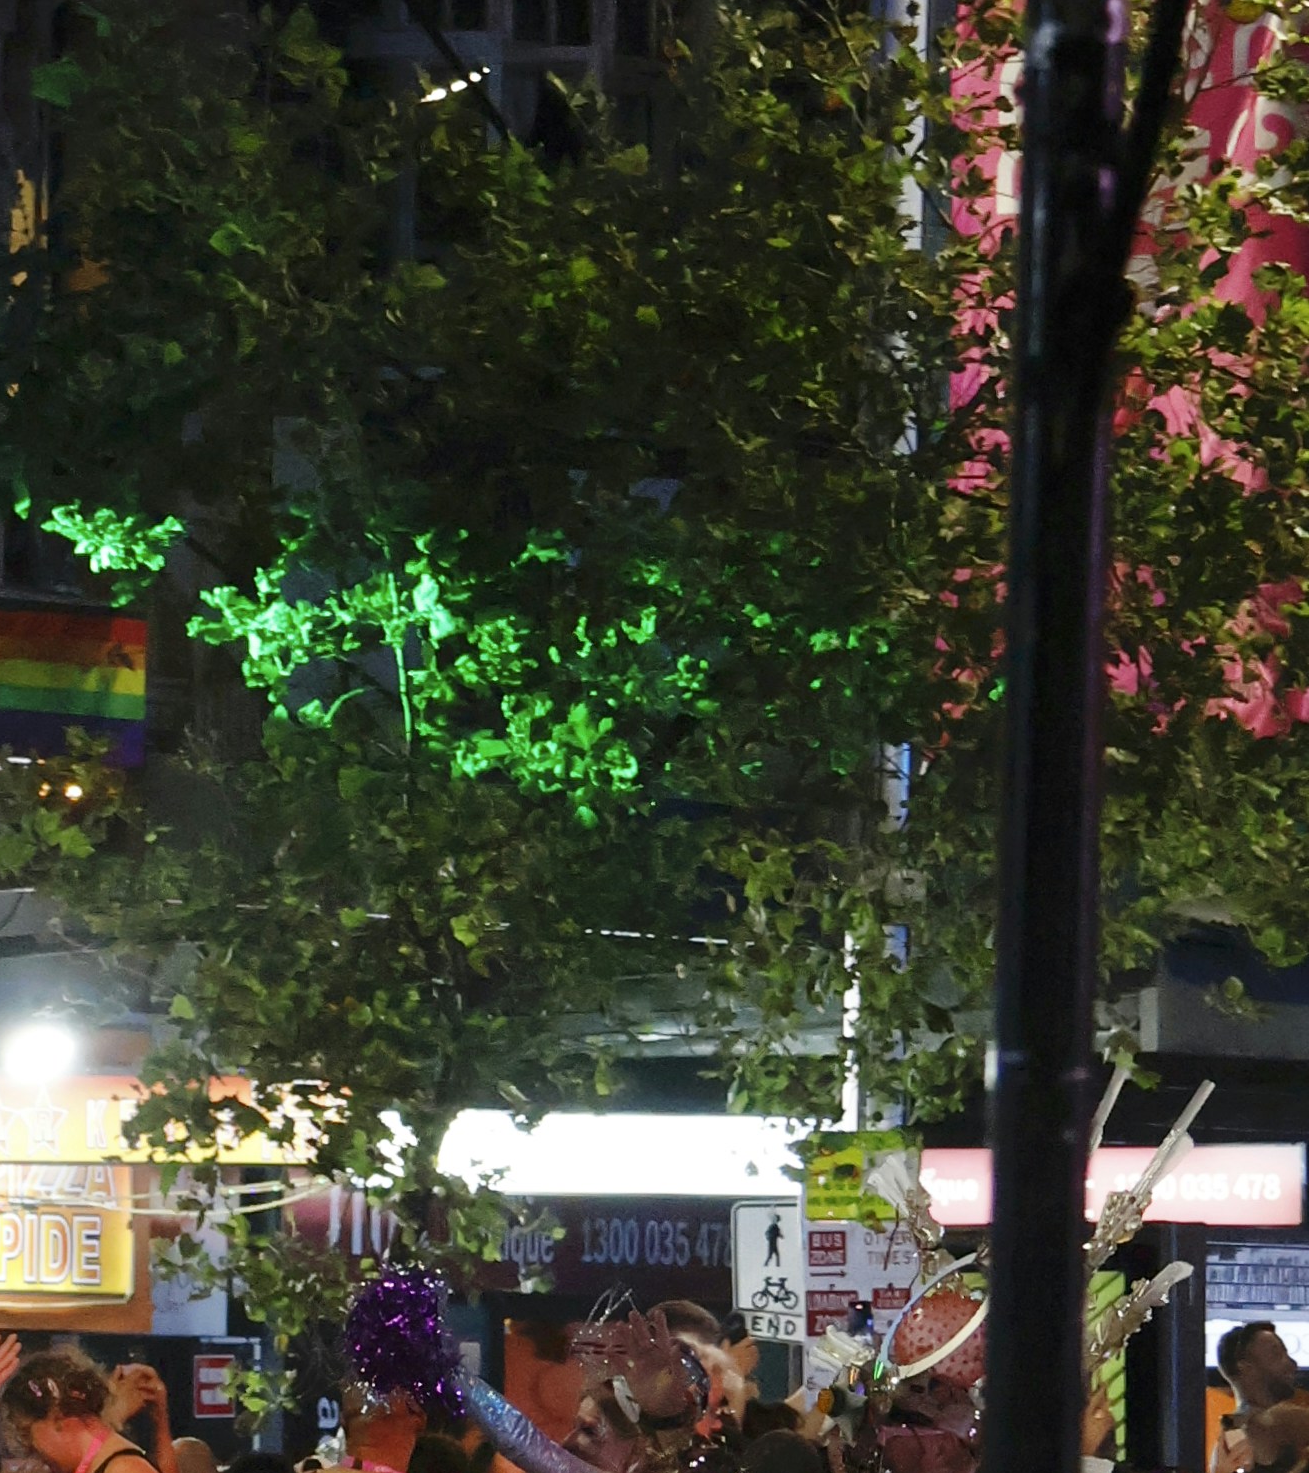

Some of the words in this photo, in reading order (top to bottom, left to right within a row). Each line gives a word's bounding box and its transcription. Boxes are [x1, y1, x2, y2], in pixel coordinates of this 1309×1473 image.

[1179, 1173, 1228, 1200] 035
[1233, 1173, 1282, 1201] 478
[580, 1217, 640, 1264] 1300
[644, 1220, 691, 1267] 035
[811, 1232, 844, 1248] BUS
[863, 1232, 914, 1246] OTHER
[867, 1250, 912, 1266] TIMES
[750, 1315, 797, 1337] END
